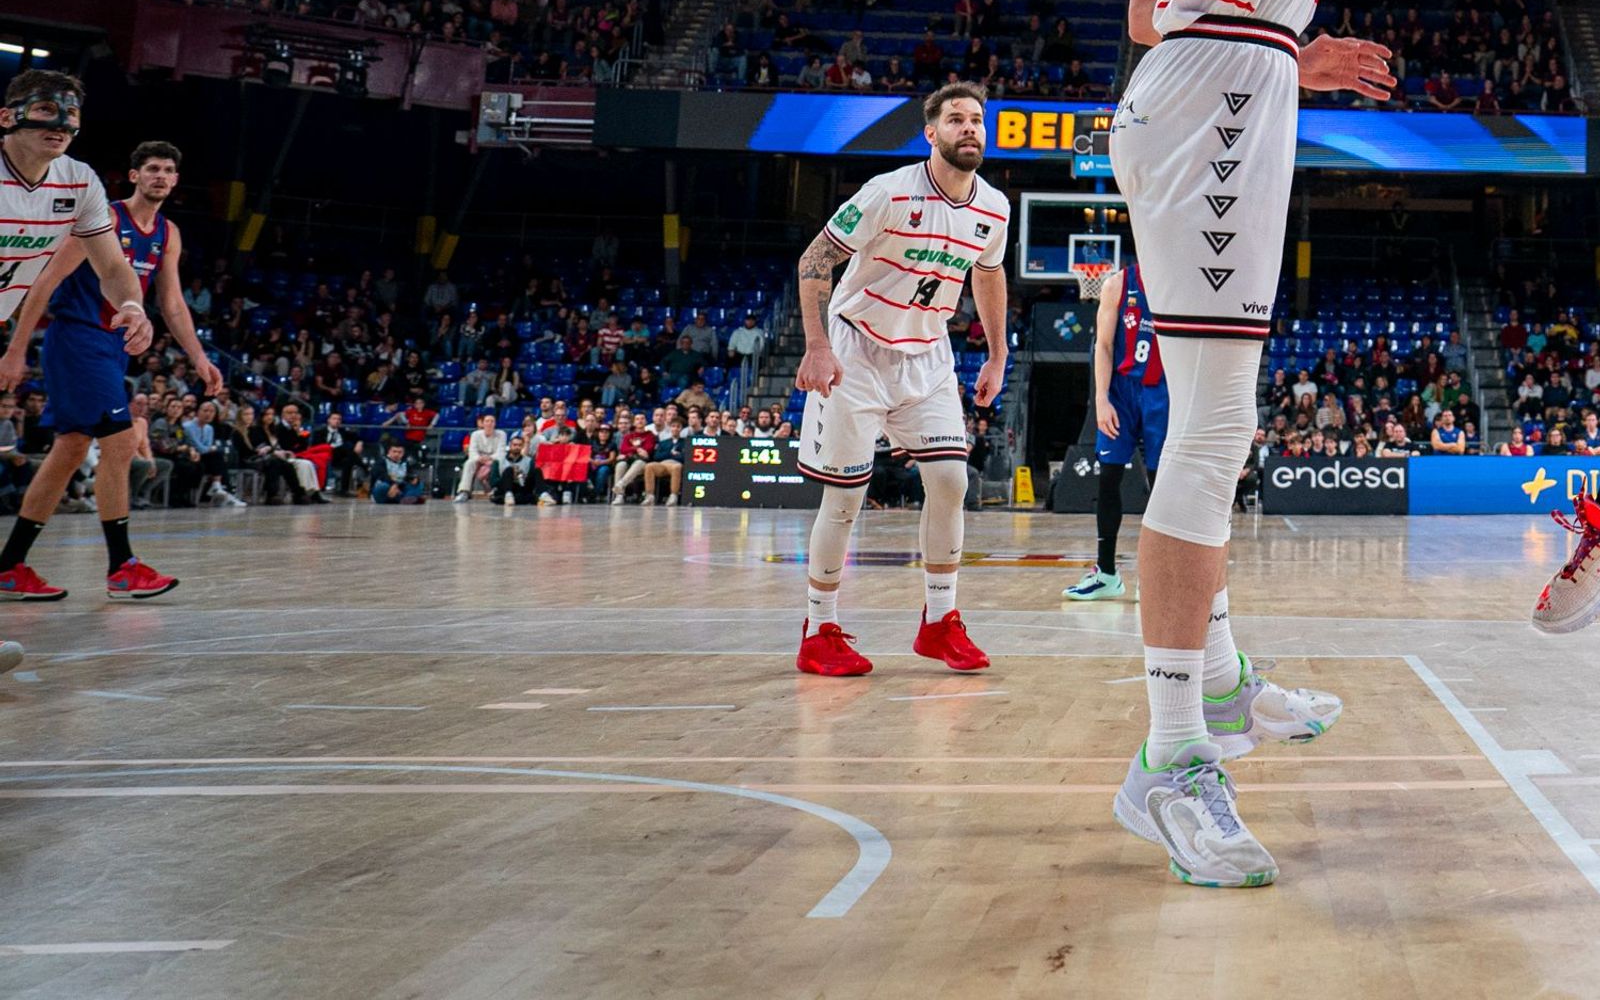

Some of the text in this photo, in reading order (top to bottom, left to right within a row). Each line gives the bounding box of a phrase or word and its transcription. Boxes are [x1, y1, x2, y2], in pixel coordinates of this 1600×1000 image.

[909, 277, 942, 306] 14
[1241, 302, 1268, 314] vive
[1135, 340, 1150, 363] 8
[693, 448, 781, 465] 52 1:41
[1272, 460, 1405, 489] endesa
[694, 486, 705, 499] 5
